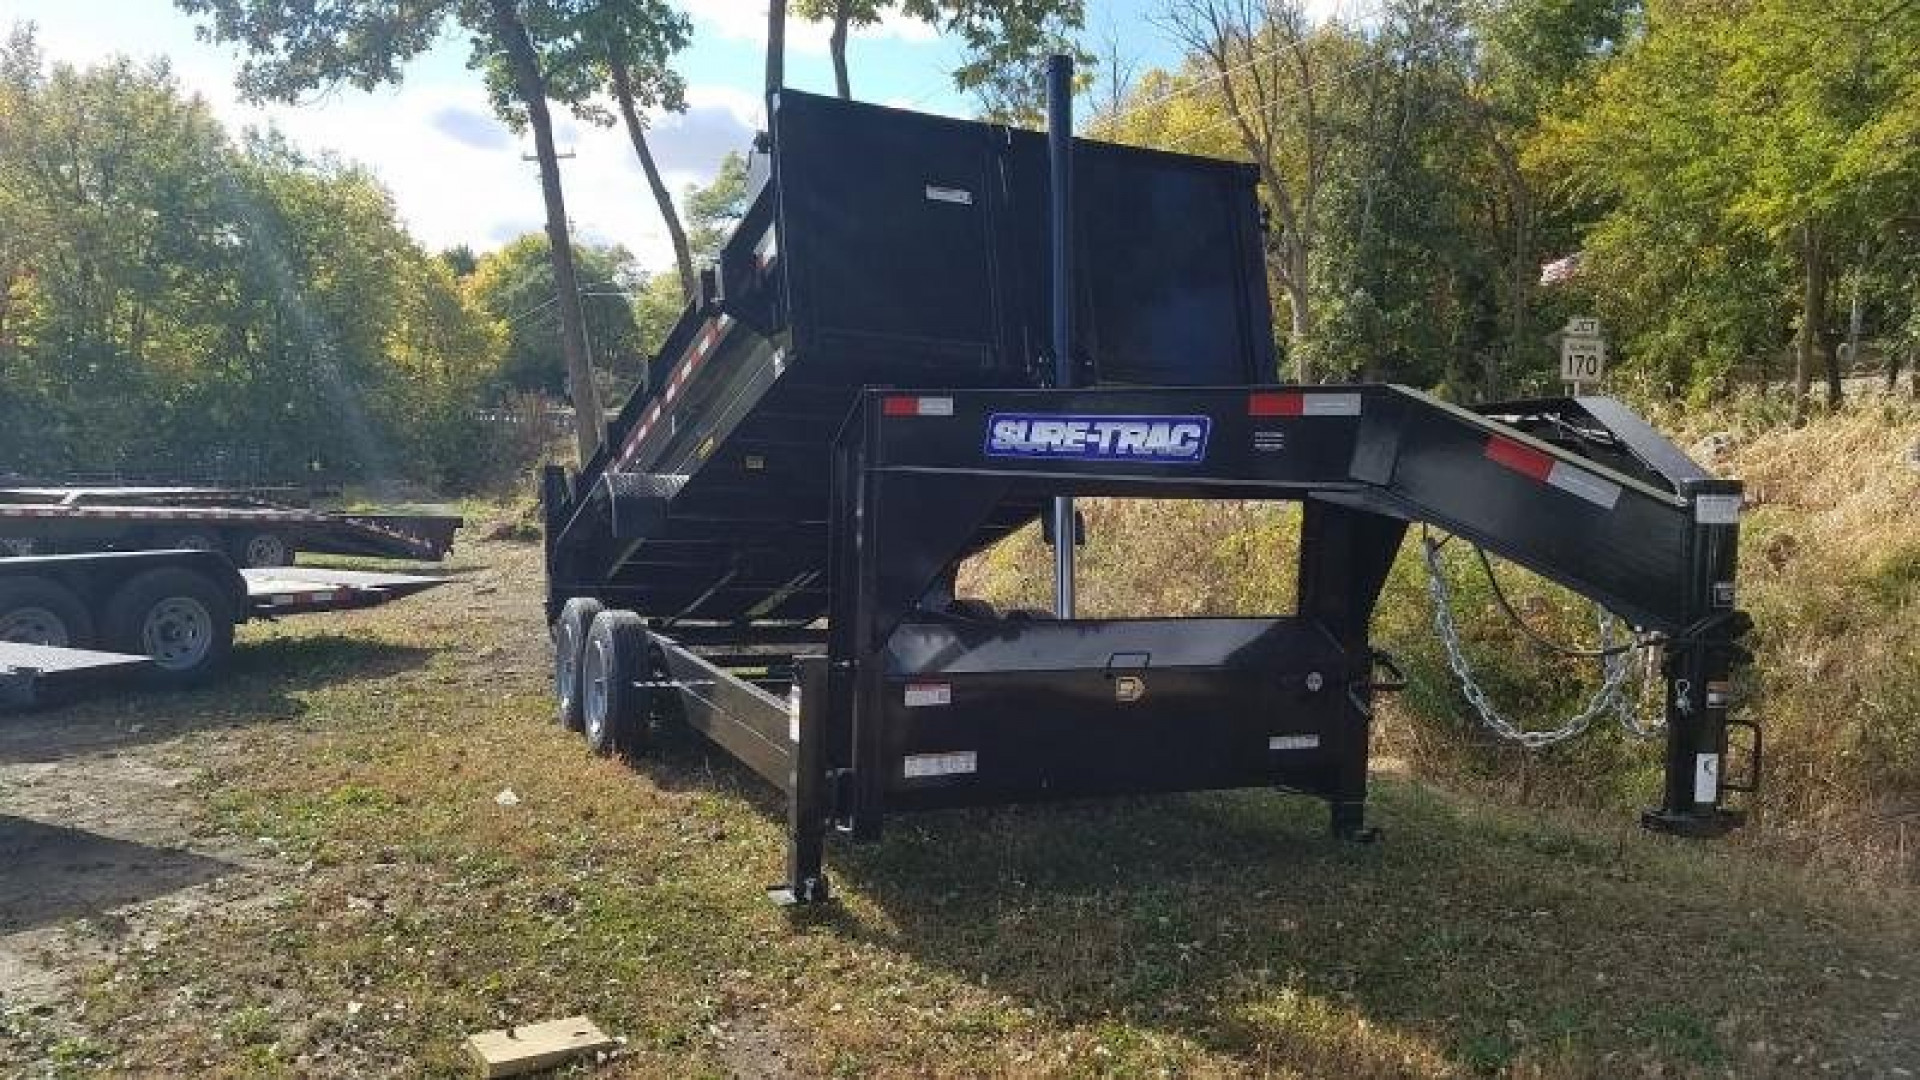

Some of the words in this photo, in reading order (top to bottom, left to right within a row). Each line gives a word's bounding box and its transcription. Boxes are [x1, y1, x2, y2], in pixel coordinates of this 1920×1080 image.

[1573, 321, 1597, 332] JCT
[1568, 354, 1597, 378] 170
[992, 419, 1202, 457] SURE-TRAC
